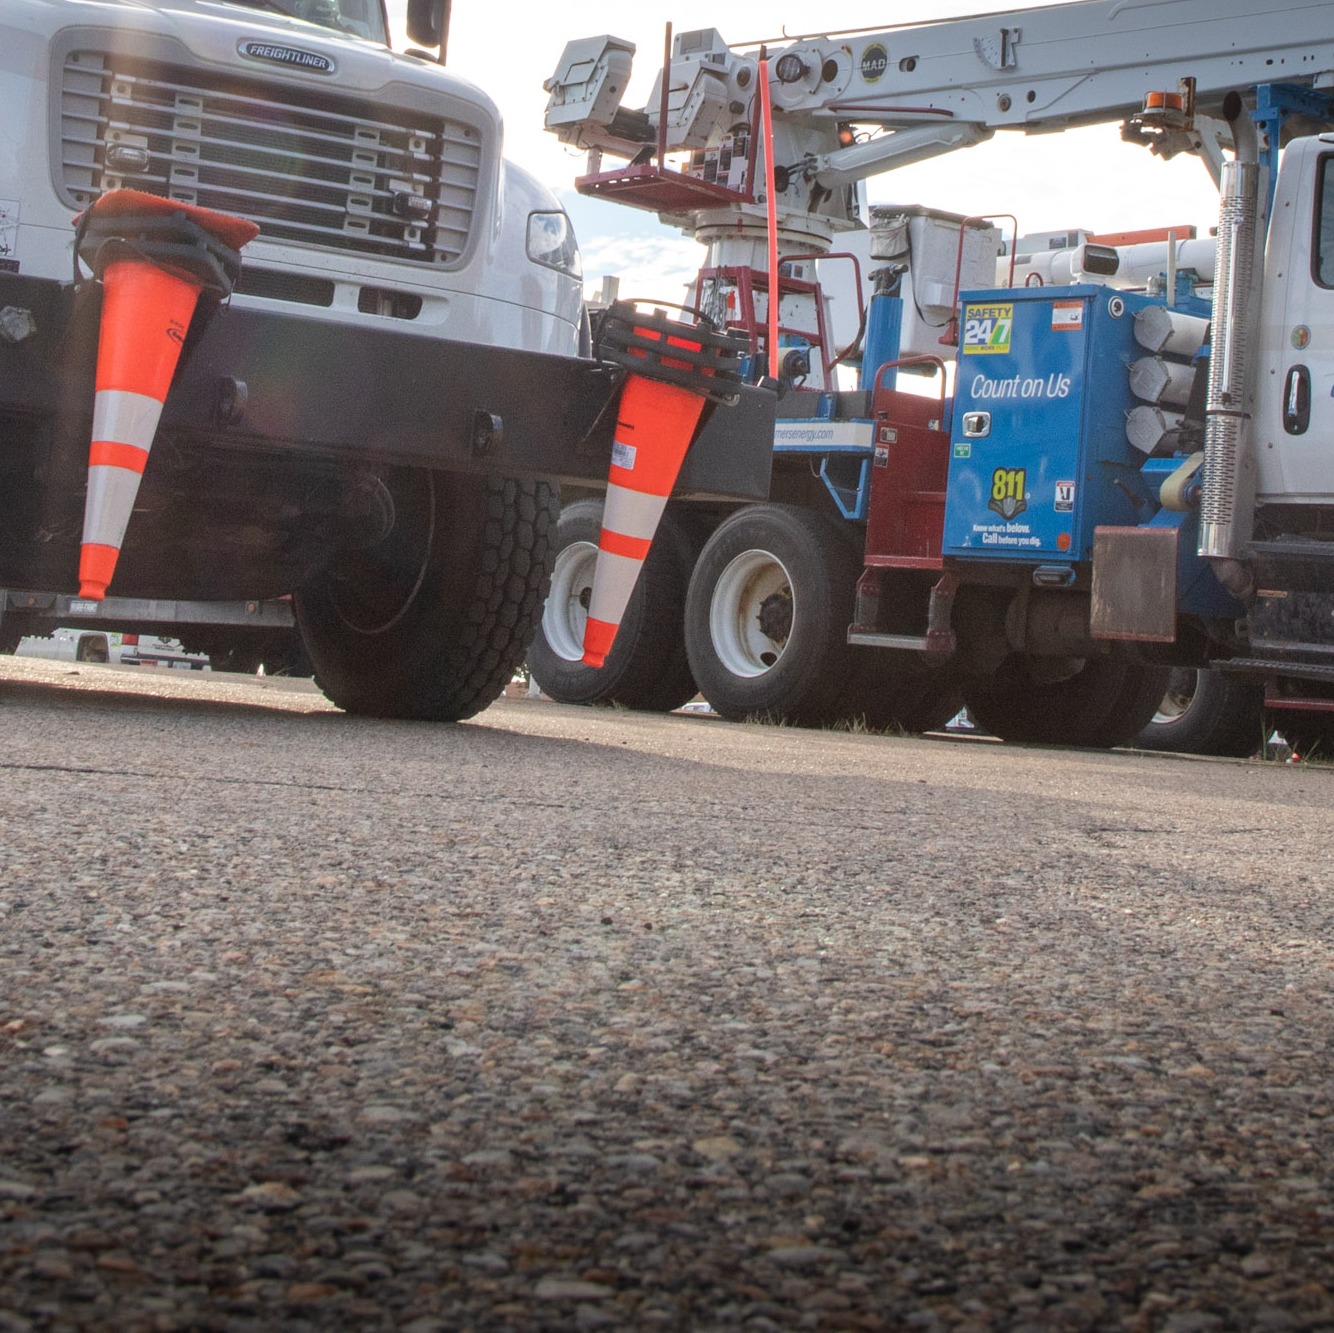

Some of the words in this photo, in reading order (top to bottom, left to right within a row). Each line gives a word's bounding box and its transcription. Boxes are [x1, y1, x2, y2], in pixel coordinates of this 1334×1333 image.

[250, 45, 326, 68] FREIGHTLINER
[967, 307, 1012, 318] SAFETY
[970, 374, 1021, 399] Count
[1021, 378, 1045, 398] on
[1046, 373, 1071, 398] Us
[775, 430, 834, 442] mersenergy.com
[992, 469, 1025, 500] 811
[982, 532, 998, 544] Call
[998, 535, 1018, 545] before
[1018, 537, 1030, 546] you
